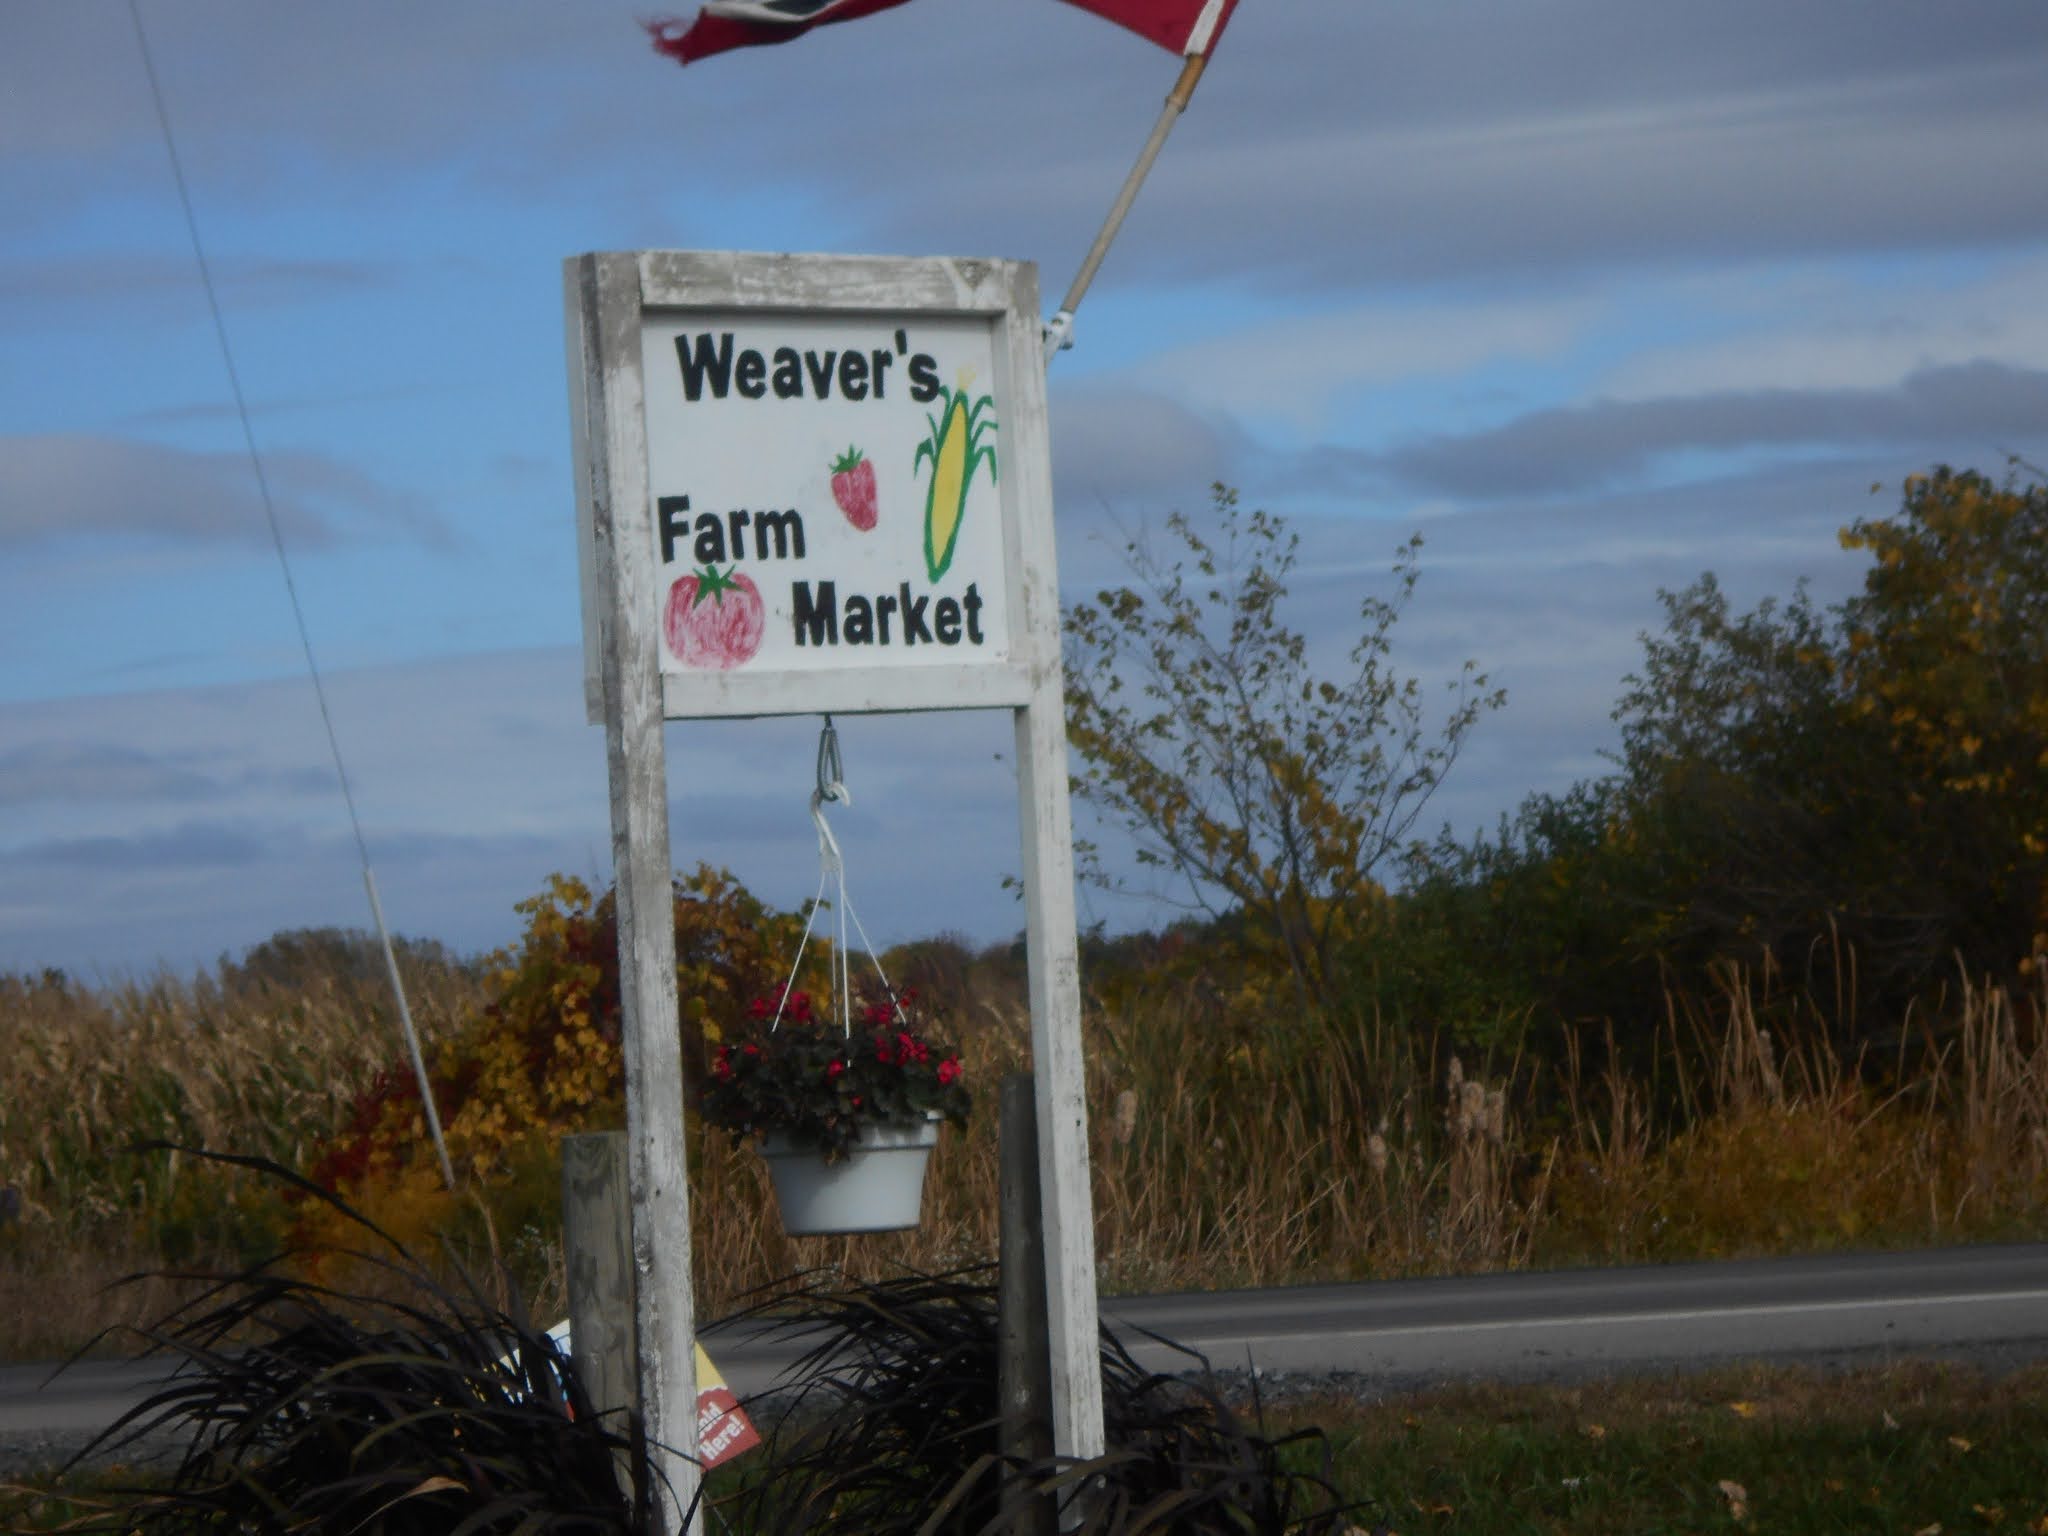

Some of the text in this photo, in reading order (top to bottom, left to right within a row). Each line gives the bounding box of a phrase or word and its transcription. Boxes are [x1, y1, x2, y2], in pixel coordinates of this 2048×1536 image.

[674, 329, 940, 402] Weaver's
[657, 495, 806, 564] Farm
[792, 581, 984, 646] Market
[699, 1415, 745, 1460] Here!
